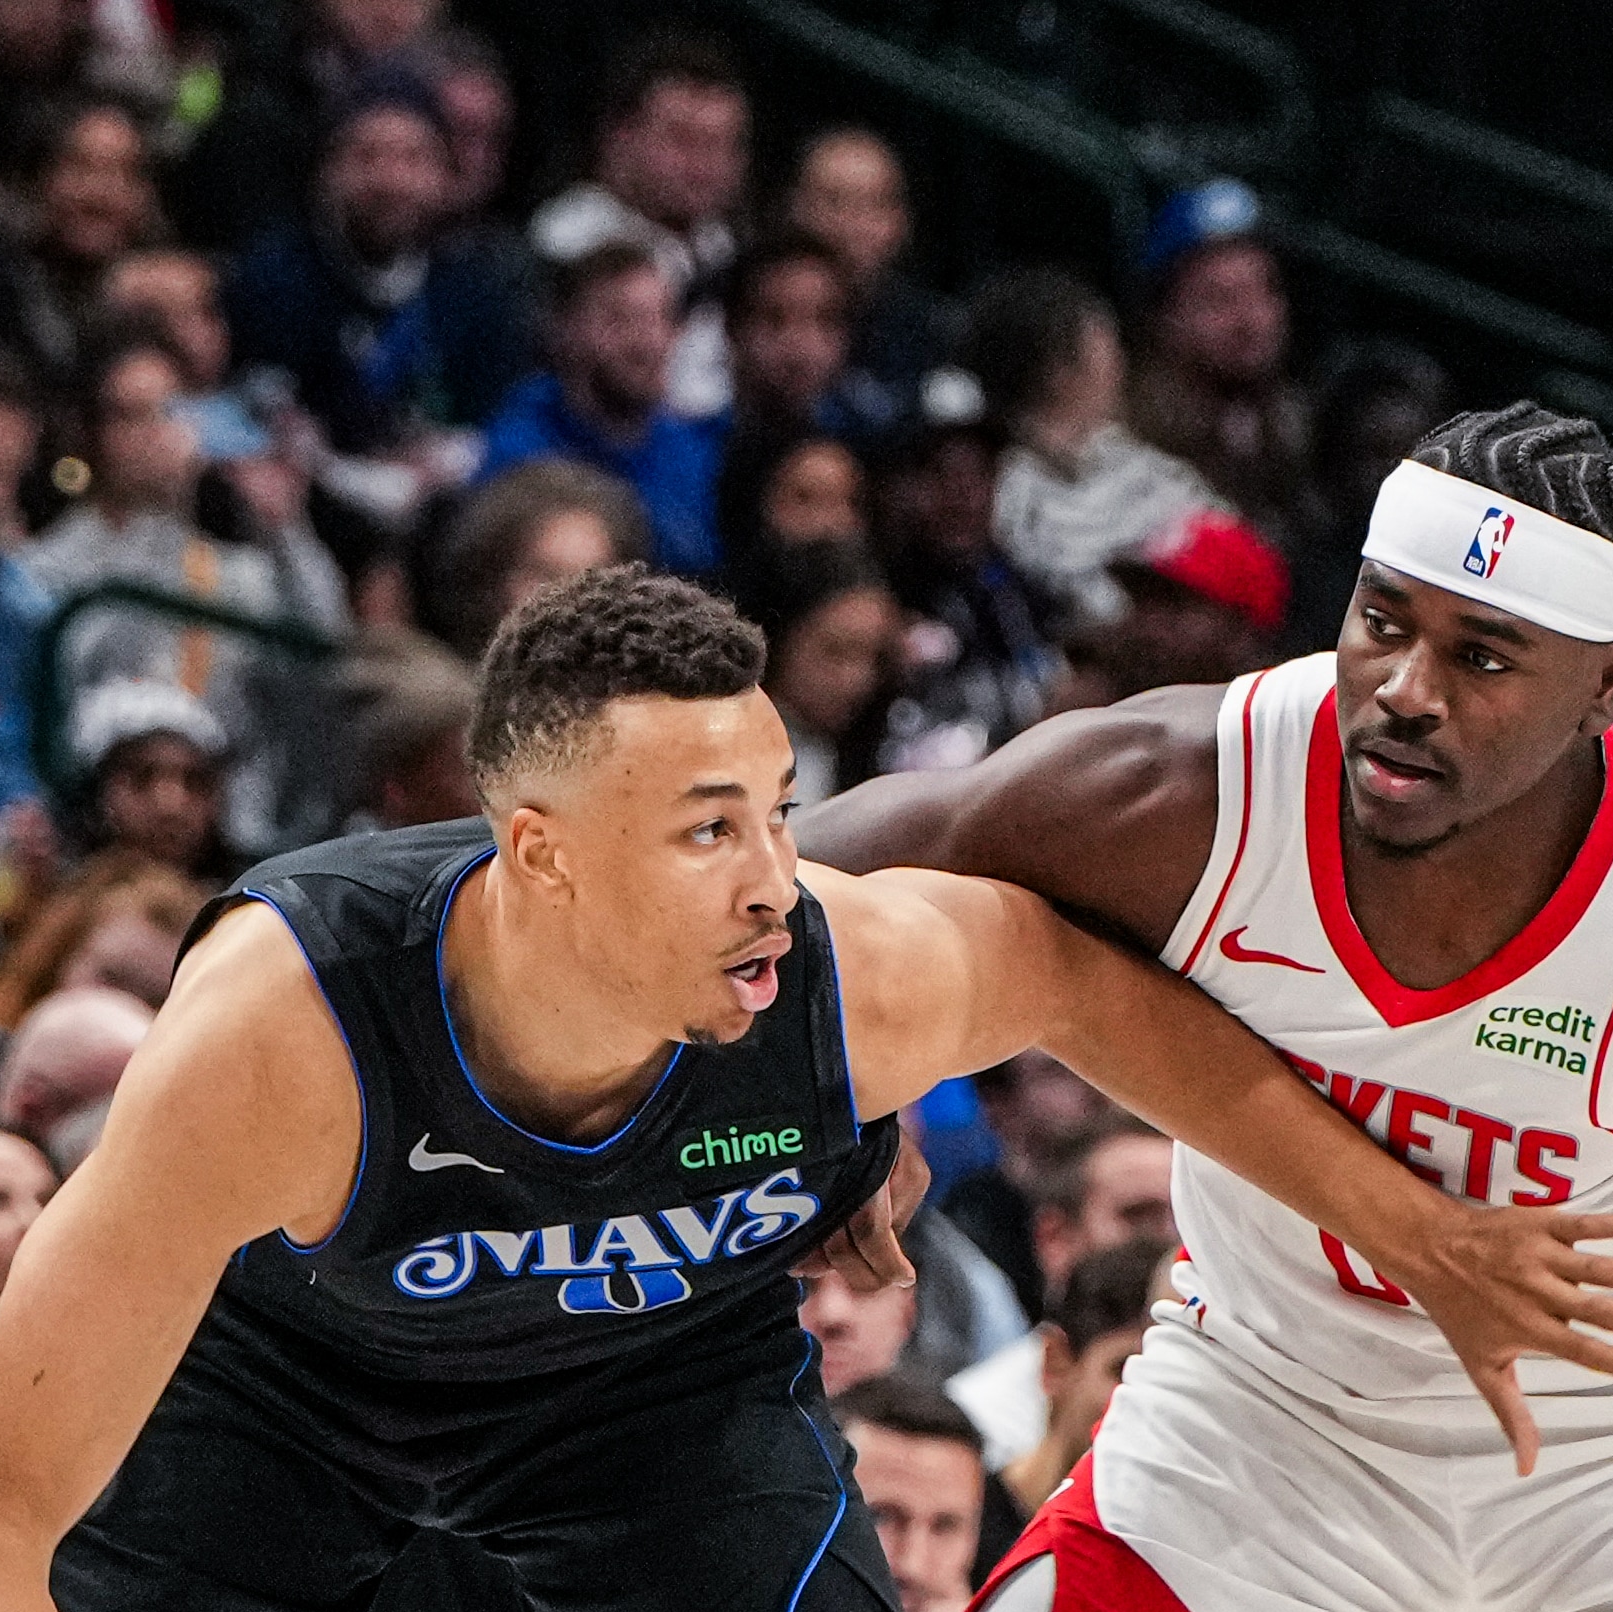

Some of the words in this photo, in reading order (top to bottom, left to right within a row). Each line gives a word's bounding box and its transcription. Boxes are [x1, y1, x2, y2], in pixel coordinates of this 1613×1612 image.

[1475, 1023, 1587, 1075] karma
[1489, 1006, 1595, 1043] credit
[680, 1125, 804, 1169] chime
[1288, 1052, 1581, 1207] KETS
[393, 1167, 820, 1300] MAVS
